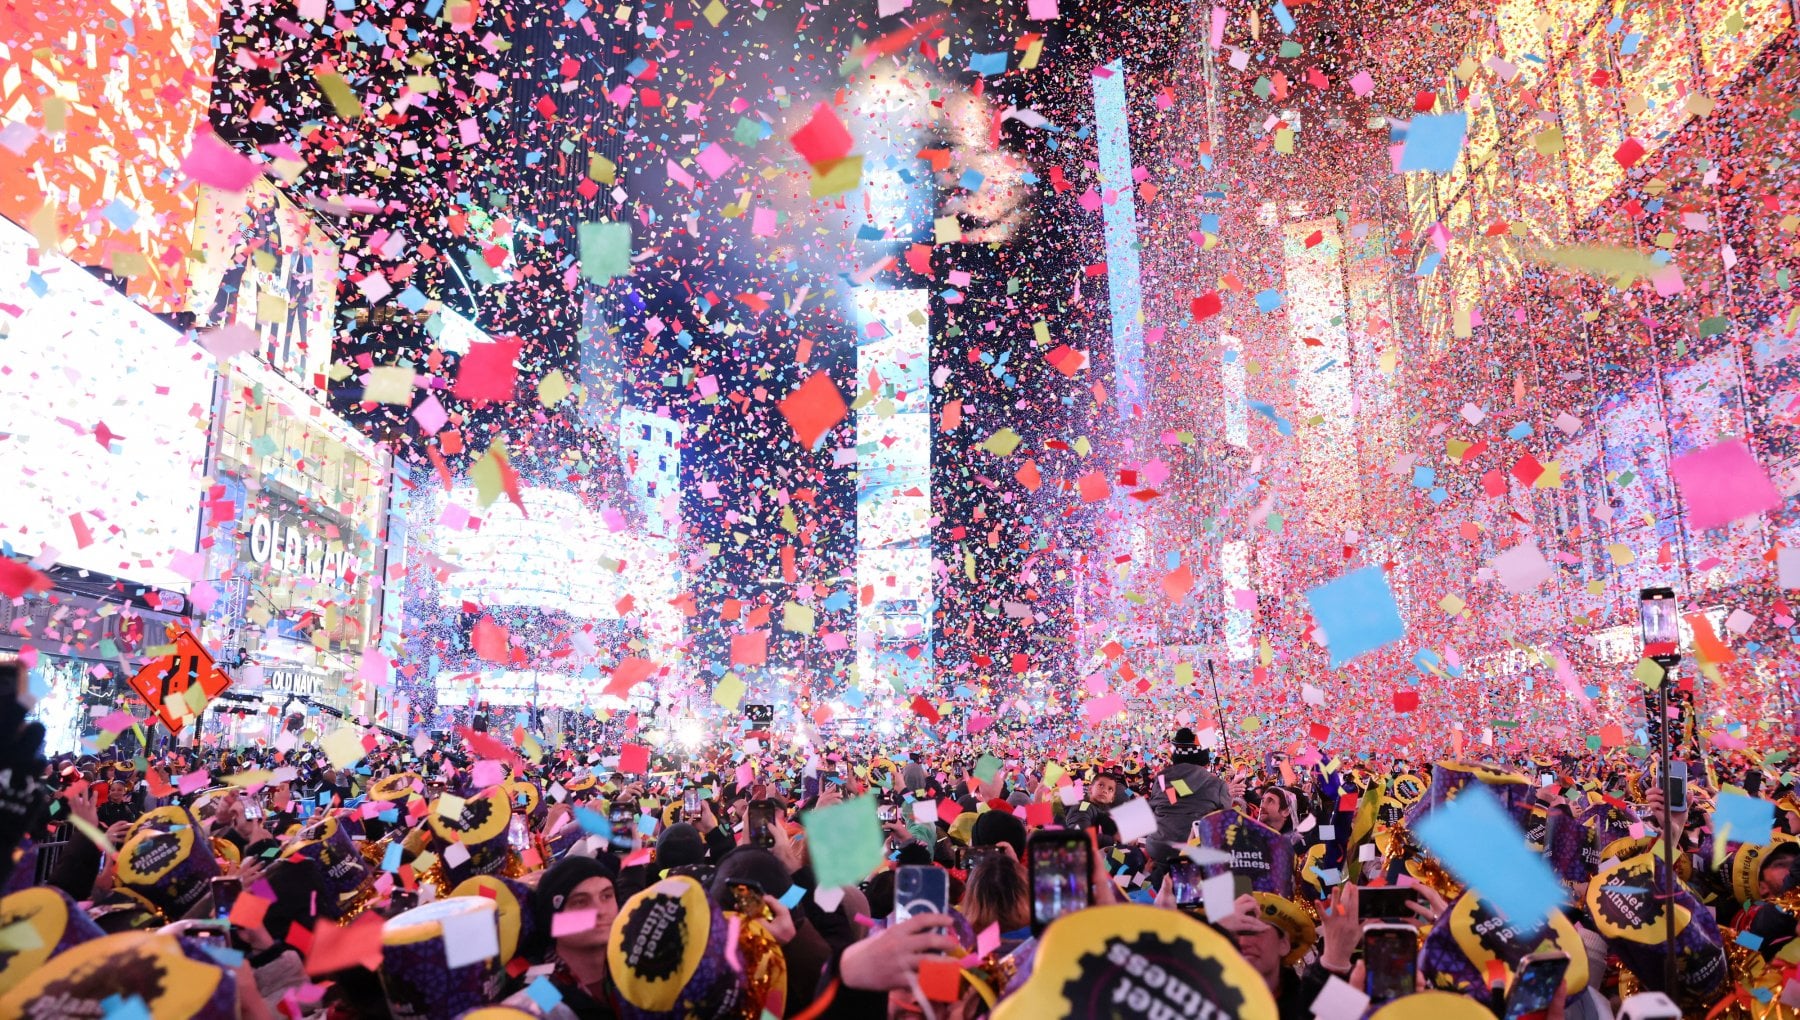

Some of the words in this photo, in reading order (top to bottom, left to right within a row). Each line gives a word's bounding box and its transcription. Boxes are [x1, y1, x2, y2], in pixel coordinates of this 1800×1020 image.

[251, 513, 302, 574] OLD
[271, 671, 293, 691] OLD
[293, 673, 322, 696] NAVY
[134, 843, 168, 869] planet
[141, 845, 179, 869] fitness
[1230, 850, 1262, 860] lanet
[1230, 859, 1270, 870] fitness
[1582, 847, 1600, 857] plan
[327, 854, 352, 877] planet
[1608, 877, 1643, 910] plnet
[628, 902, 667, 965] fitness
[644, 901, 679, 959] planet
[1107, 943, 1233, 1020] itness
[26, 992, 103, 1016] plan
